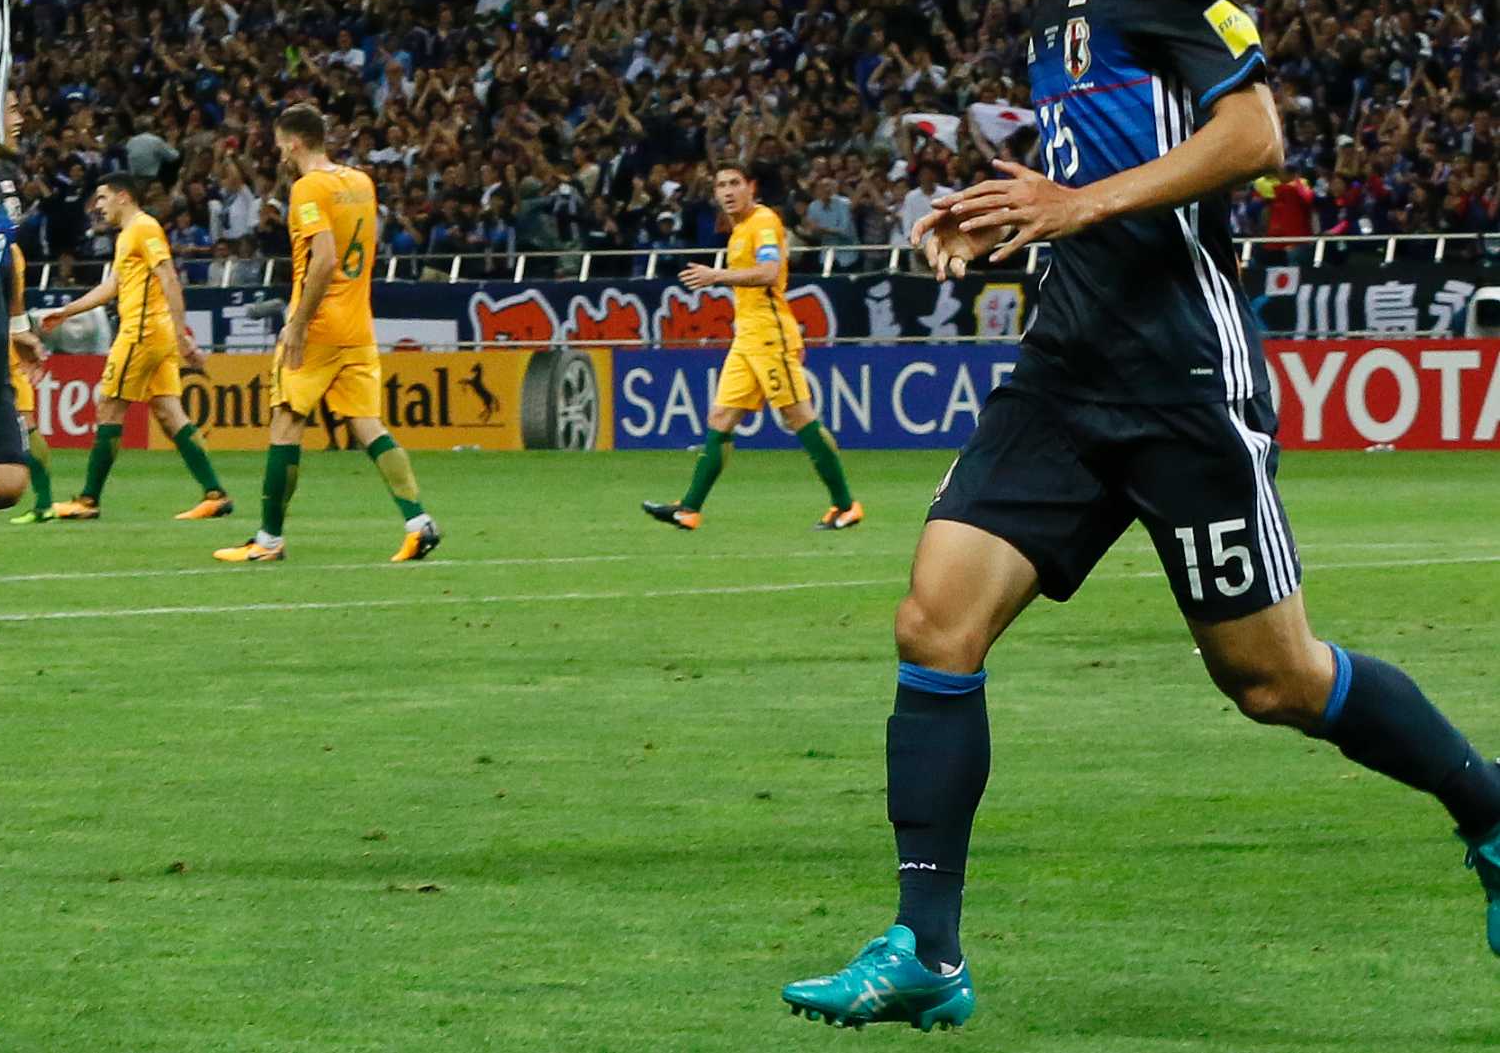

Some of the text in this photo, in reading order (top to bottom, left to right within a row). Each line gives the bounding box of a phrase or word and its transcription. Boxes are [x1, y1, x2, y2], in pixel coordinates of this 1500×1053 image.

[342, 218, 364, 279] 6
[1265, 347, 1500, 442] YOT
[1174, 517, 1255, 601] 15
